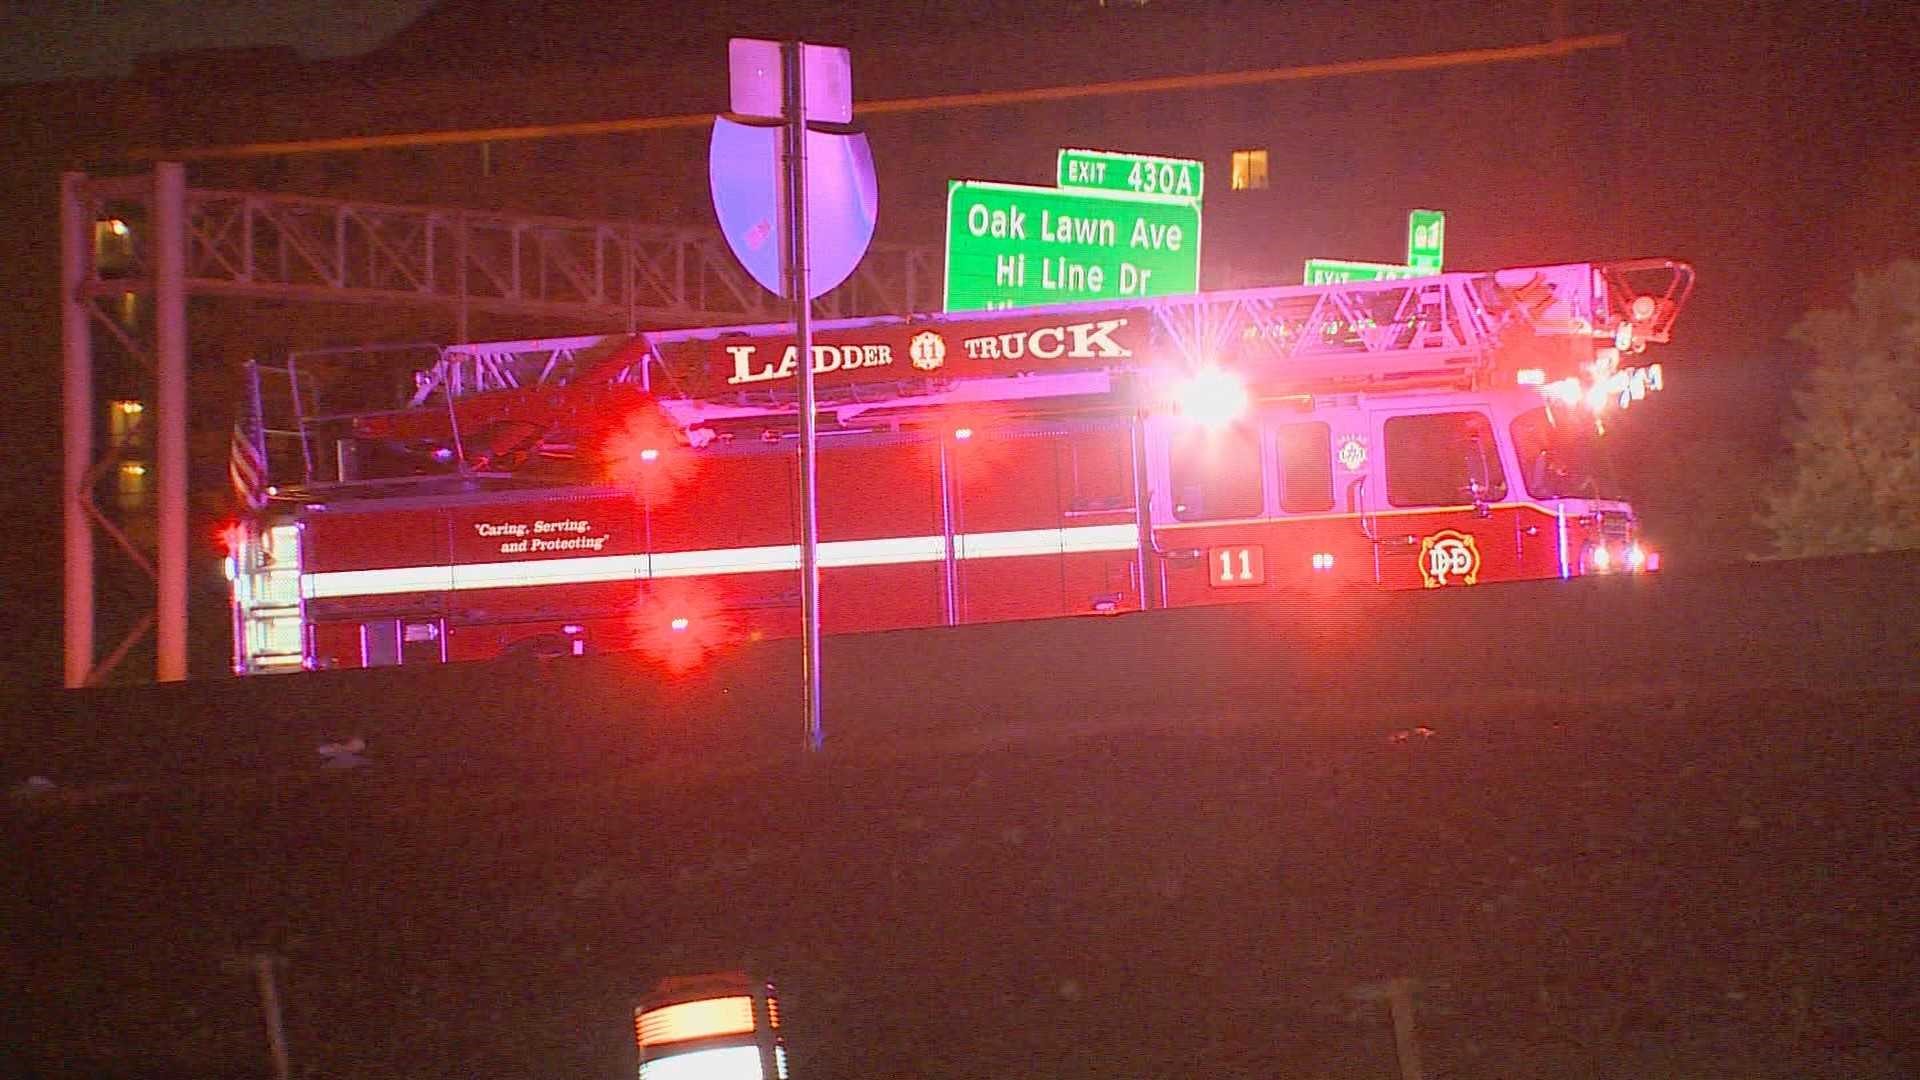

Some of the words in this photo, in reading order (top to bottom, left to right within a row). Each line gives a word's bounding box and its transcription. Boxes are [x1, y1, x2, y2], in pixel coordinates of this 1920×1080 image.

[1069, 160, 1106, 183] EXIT
[1128, 161, 1192, 195] 430A
[968, 203, 1026, 240] Oak
[1041, 210, 1116, 247] Lawn
[1130, 217, 1183, 251] Ave
[996, 253, 1025, 287] Hi
[1042, 256, 1104, 292] Line
[1119, 262, 1152, 295] Dr
[726, 345, 893, 385] LADDER
[964, 318, 1132, 360] TRUCK
[501, 540, 528, 553] and
[1219, 550, 1252, 580] 11
